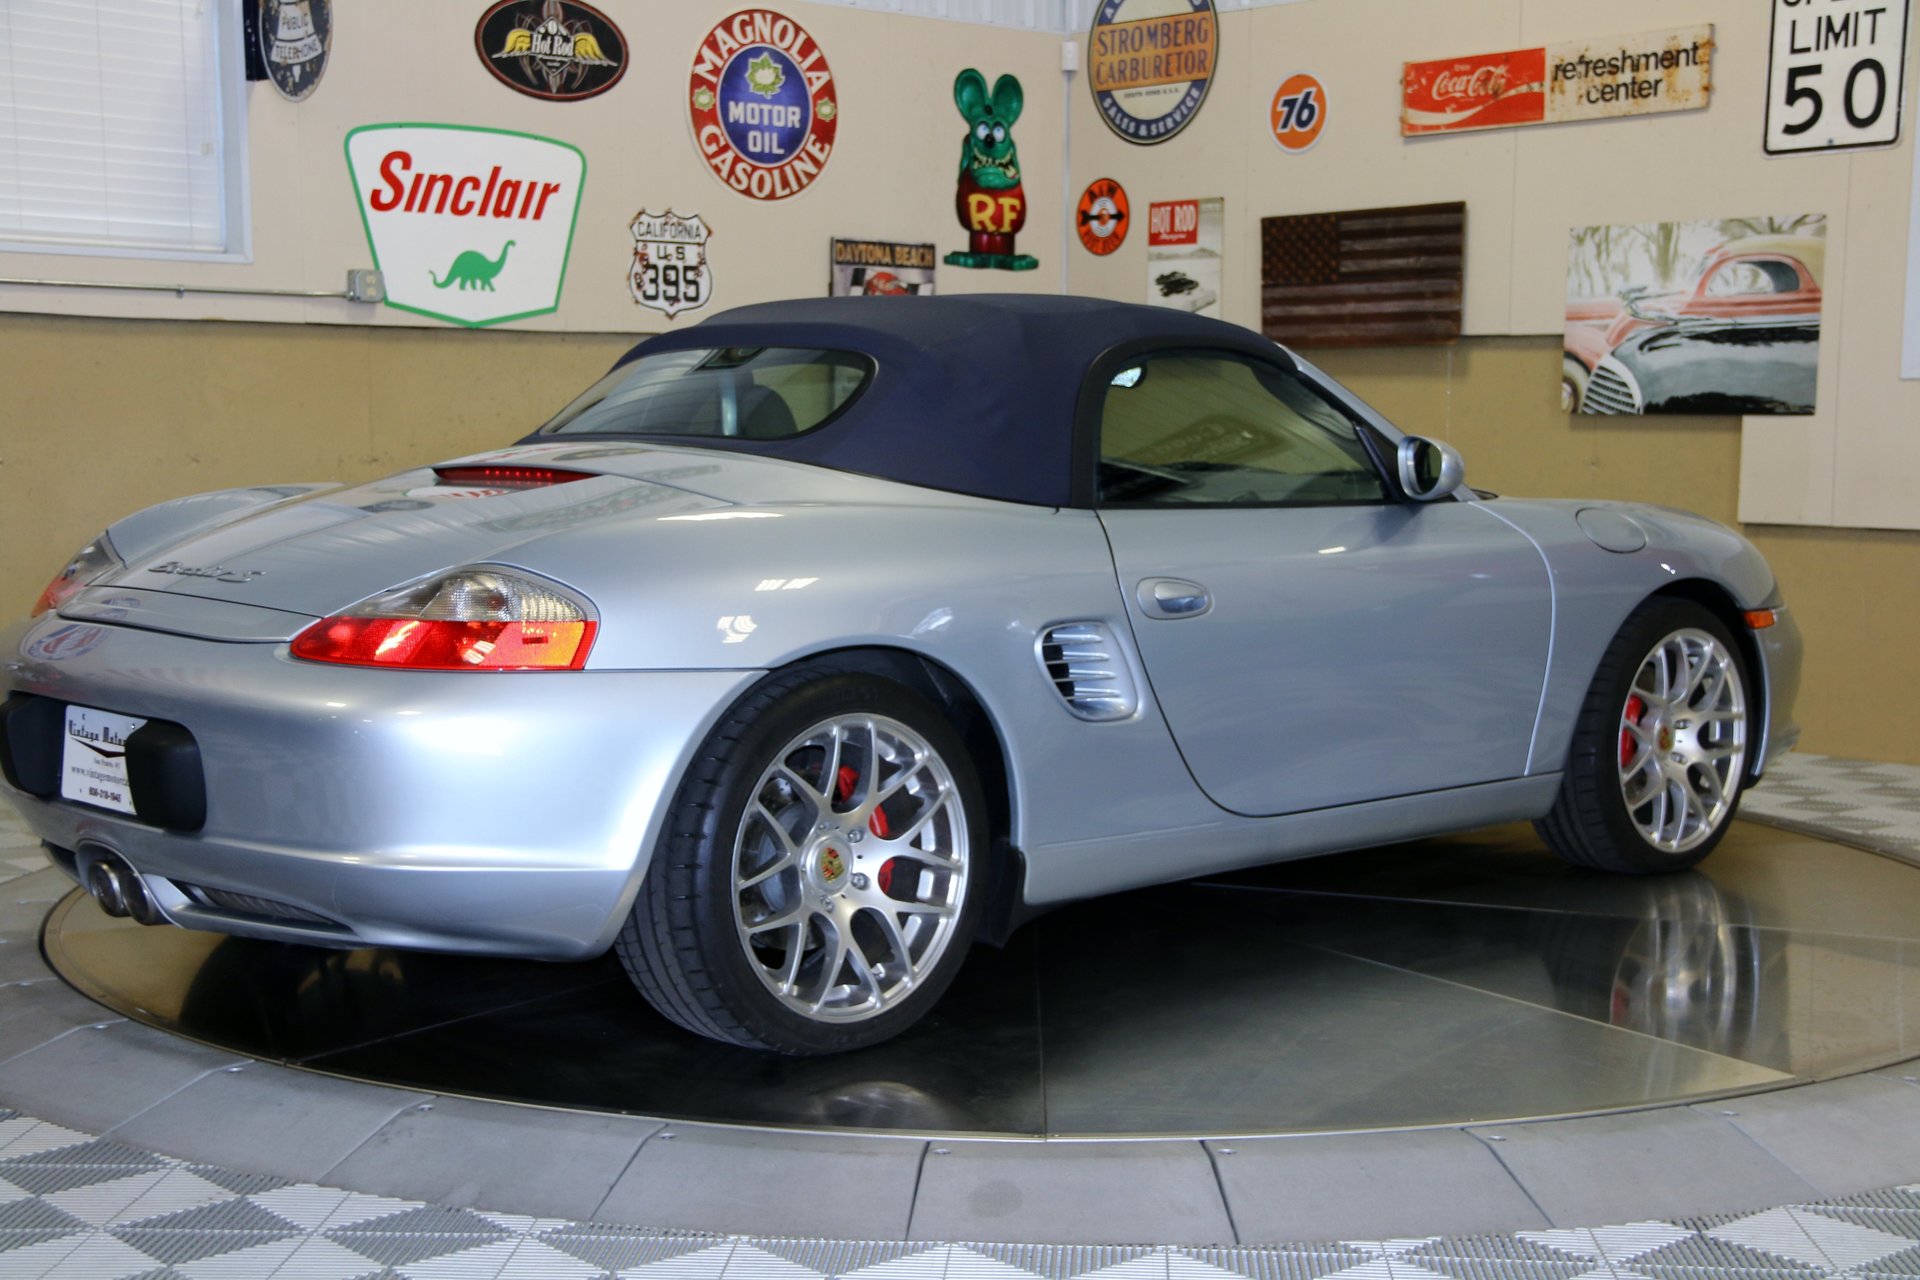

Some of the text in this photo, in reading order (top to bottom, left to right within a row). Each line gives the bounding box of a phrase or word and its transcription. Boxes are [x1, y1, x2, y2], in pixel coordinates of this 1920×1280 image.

[274, 37, 320, 61] TELEPHONE
[530, 33, 575, 57] Hot Rod
[1096, 17, 1209, 57] STROMBERG
[1789, 8, 1887, 55] LIMIT
[693, 13, 831, 96] MAGNOLIA
[1096, 49, 1208, 85] CARBURETOR
[1553, 41, 1700, 82] refreshment
[1586, 76, 1664, 104] center
[1781, 58, 1887, 135] 50
[728, 101, 801, 129] MOTOR
[1103, 87, 1200, 137] SALES & SERVICE
[1277, 87, 1318, 133] 76
[700, 124, 831, 198] GASOLINE
[747, 130, 785, 154] OIL
[369, 150, 561, 221] Sinclair
[637, 222, 702, 240] CALIFORNIA
[967, 193, 1022, 233] RF
[1151, 204, 1197, 234] HOT ROD
[836, 243, 933, 268] DAYTONA BEACH
[641, 264, 700, 302] 395
